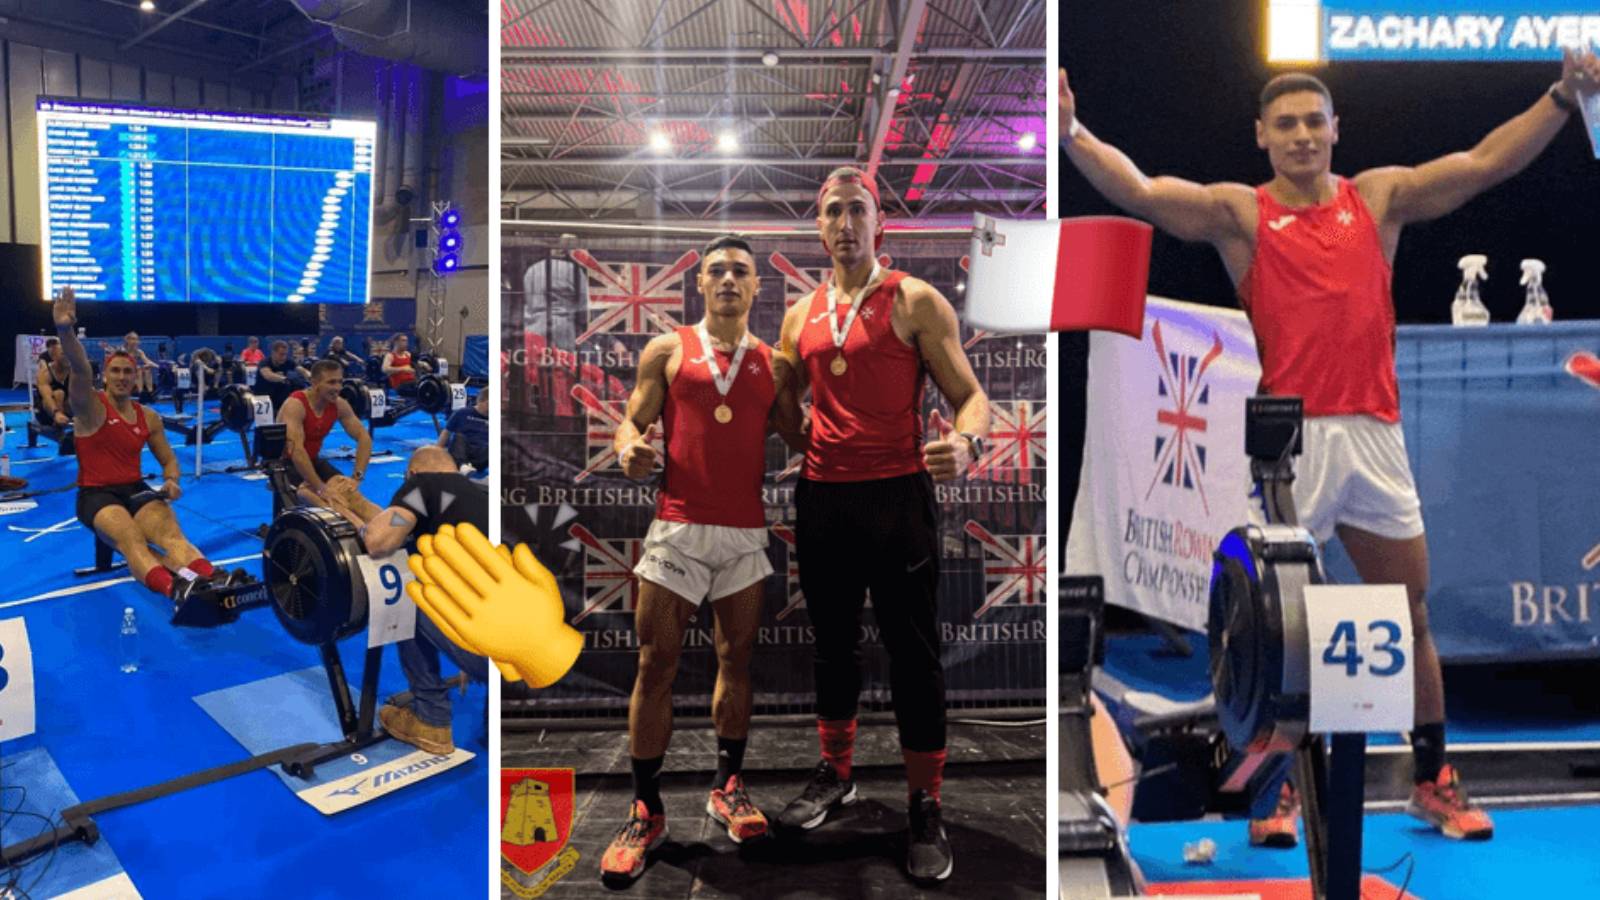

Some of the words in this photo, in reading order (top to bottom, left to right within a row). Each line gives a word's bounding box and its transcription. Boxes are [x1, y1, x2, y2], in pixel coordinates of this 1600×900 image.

[1328, 14, 1505, 50] ZACHARY
[539, 346, 638, 368] BRITISH
[255, 400, 271, 415] 27
[371, 394, 385, 407] 28
[378, 563, 403, 606] 9
[1322, 619, 1406, 678] 43
